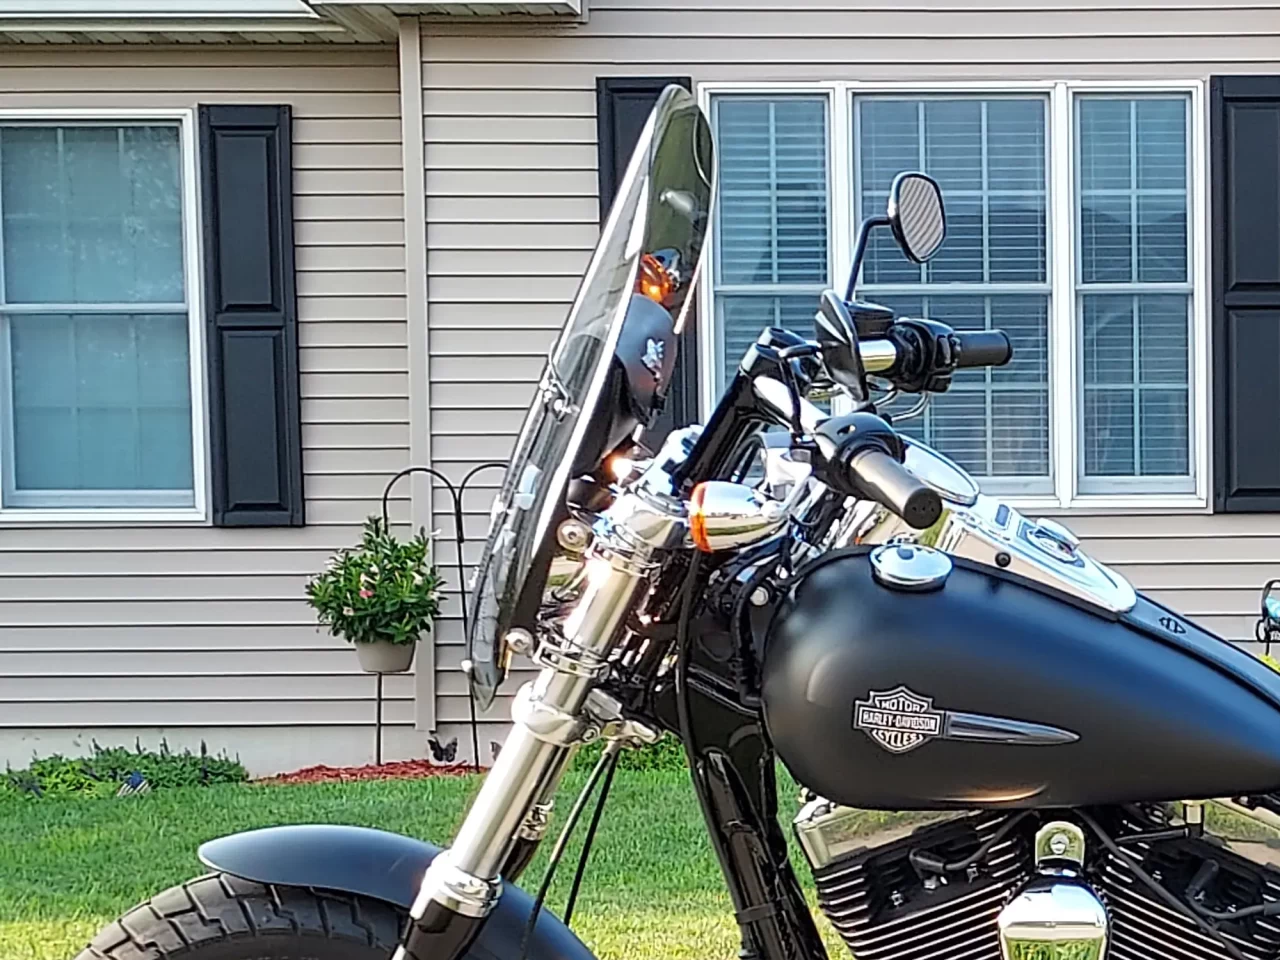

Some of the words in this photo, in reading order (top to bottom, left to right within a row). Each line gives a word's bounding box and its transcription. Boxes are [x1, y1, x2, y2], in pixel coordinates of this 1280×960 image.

[881, 697, 921, 713] MOTOR
[863, 711, 936, 730] HARLEY-DAVIDSON
[878, 729, 917, 747] CYCLES
